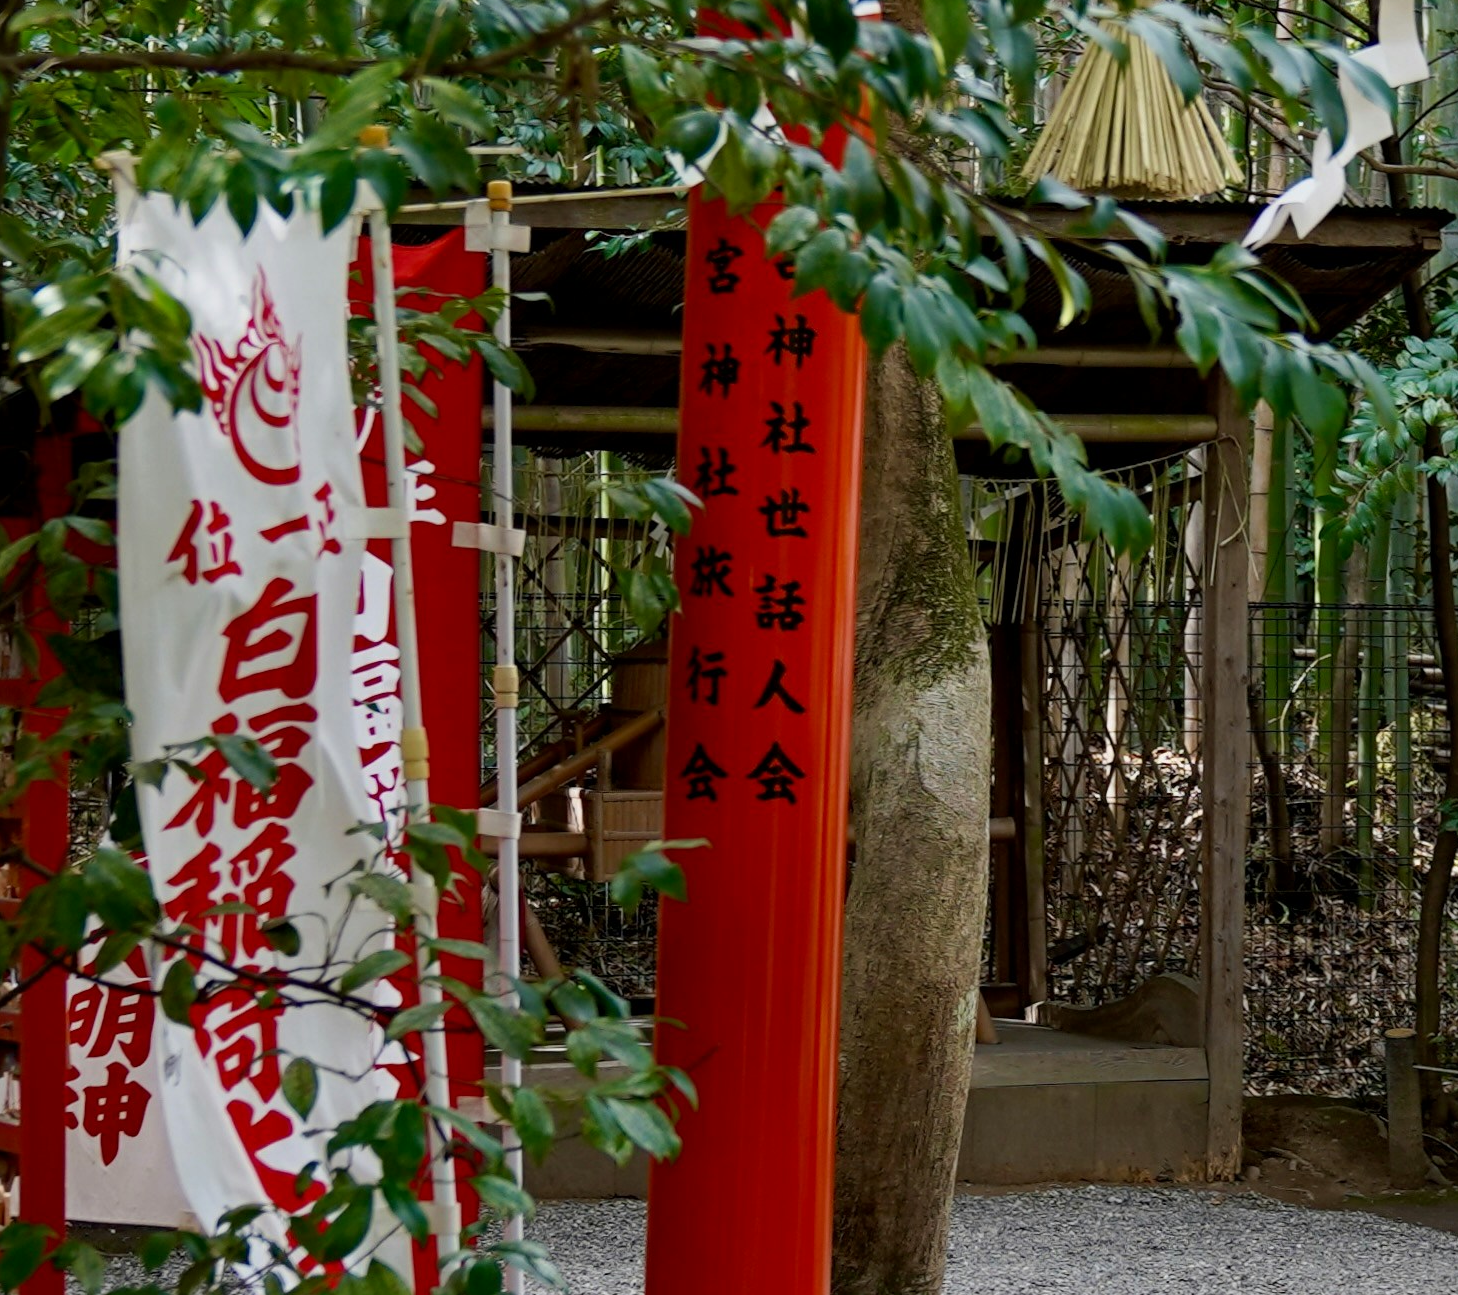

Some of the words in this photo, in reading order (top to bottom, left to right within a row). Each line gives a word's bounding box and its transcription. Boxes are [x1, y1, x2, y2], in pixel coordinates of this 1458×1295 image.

[680, 239, 742, 803] 宮神社旅行会
